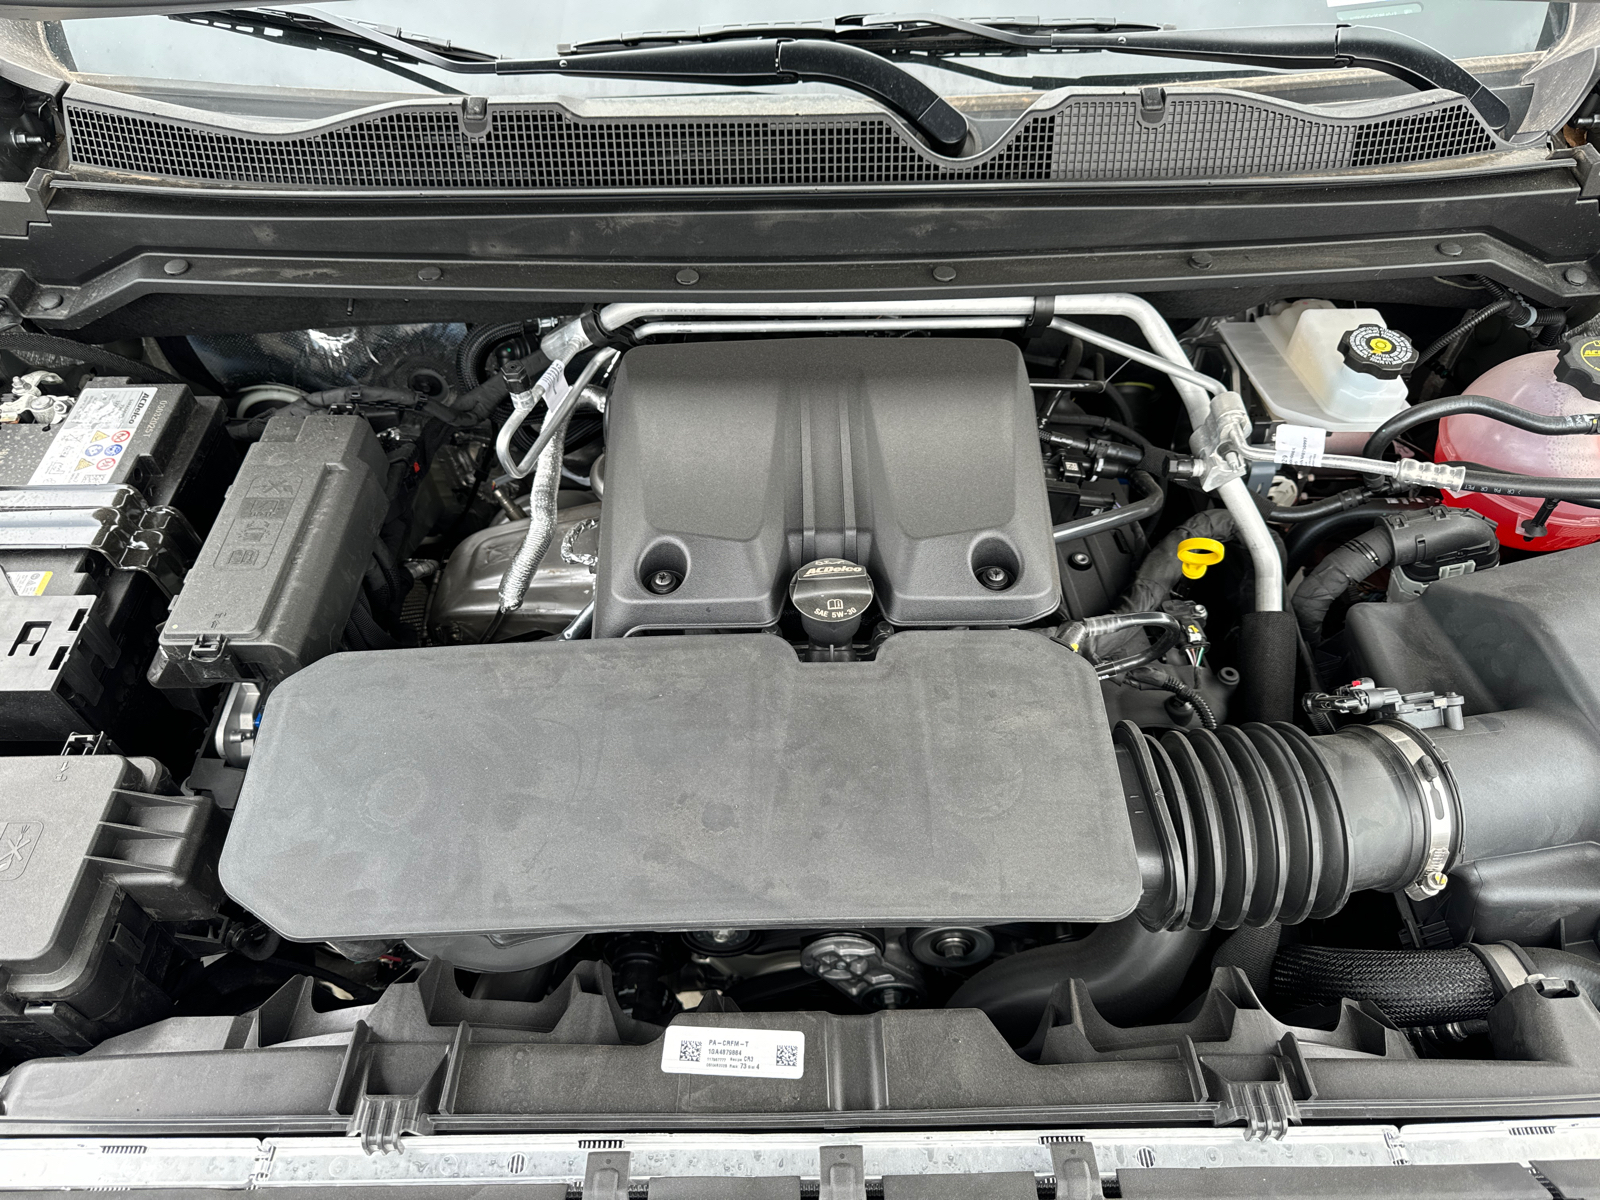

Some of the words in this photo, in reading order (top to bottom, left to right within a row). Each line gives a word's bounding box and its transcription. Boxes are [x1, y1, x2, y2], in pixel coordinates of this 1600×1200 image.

[128, 392, 150, 425] ACDelco
[804, 566, 862, 576] ACDelco
[814, 608, 829, 618] SAE
[831, 607, 857, 618] 5W-30
